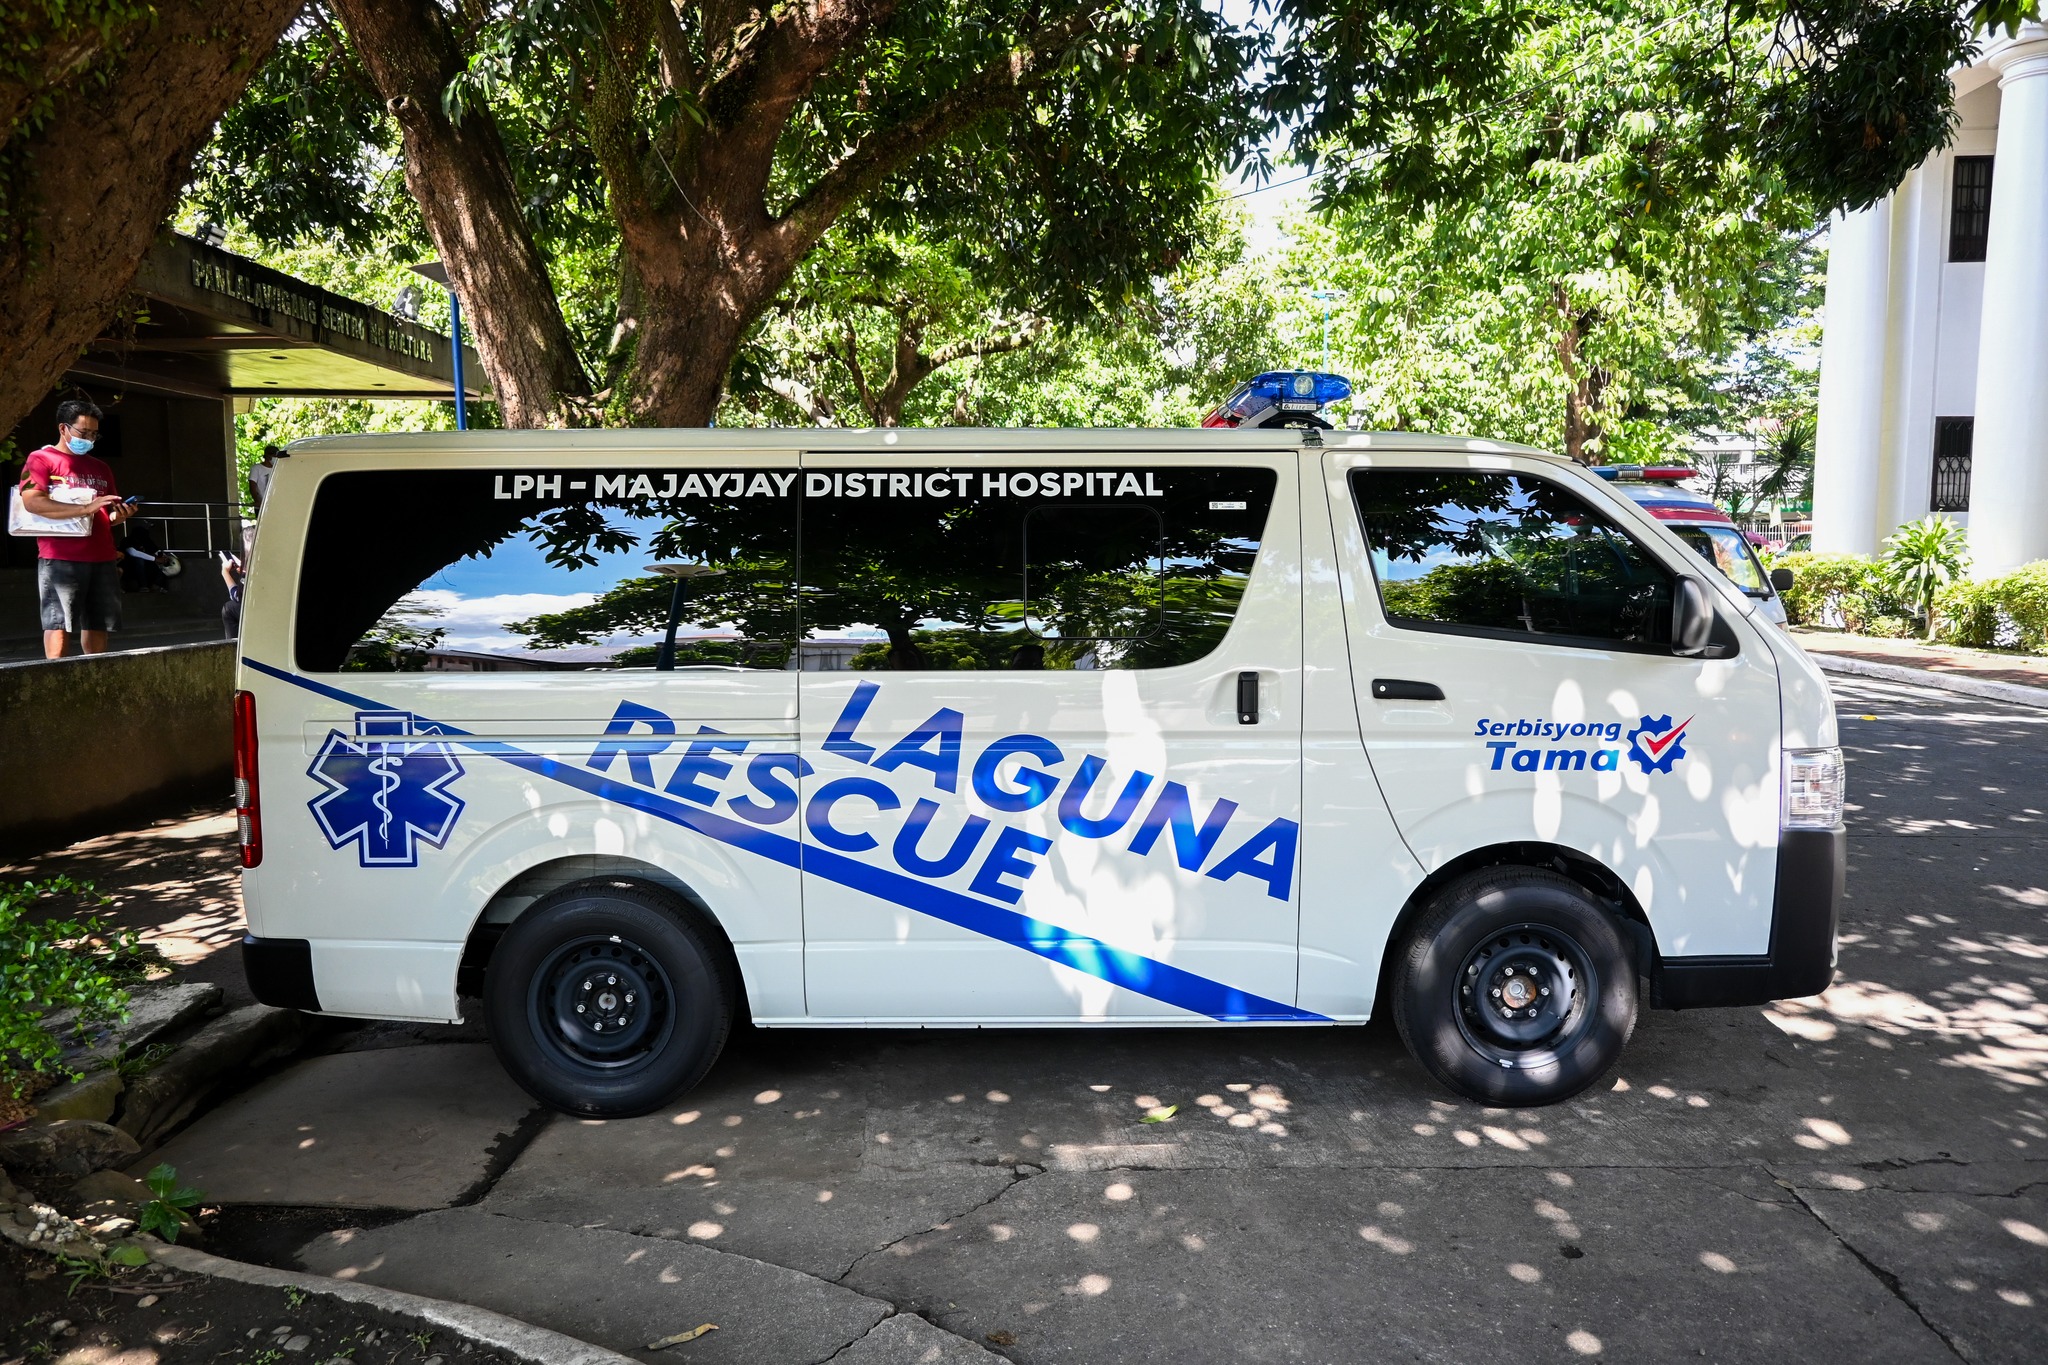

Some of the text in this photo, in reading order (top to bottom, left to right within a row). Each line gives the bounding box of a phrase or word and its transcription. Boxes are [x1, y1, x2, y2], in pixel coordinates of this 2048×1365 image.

[321, 304, 365, 340] SENTRO
[494, 474, 562, 499] LPH
[594, 473, 797, 499] MAJAYJAY
[805, 472, 973, 498] DISTRICT
[982, 472, 1164, 497] HOSPITAL
[1475, 718, 1622, 741] Serbisyong
[1486, 741, 1620, 772] Tama
[585, 699, 1054, 906] RESCUE
[821, 679, 1300, 902] LAGUNA
